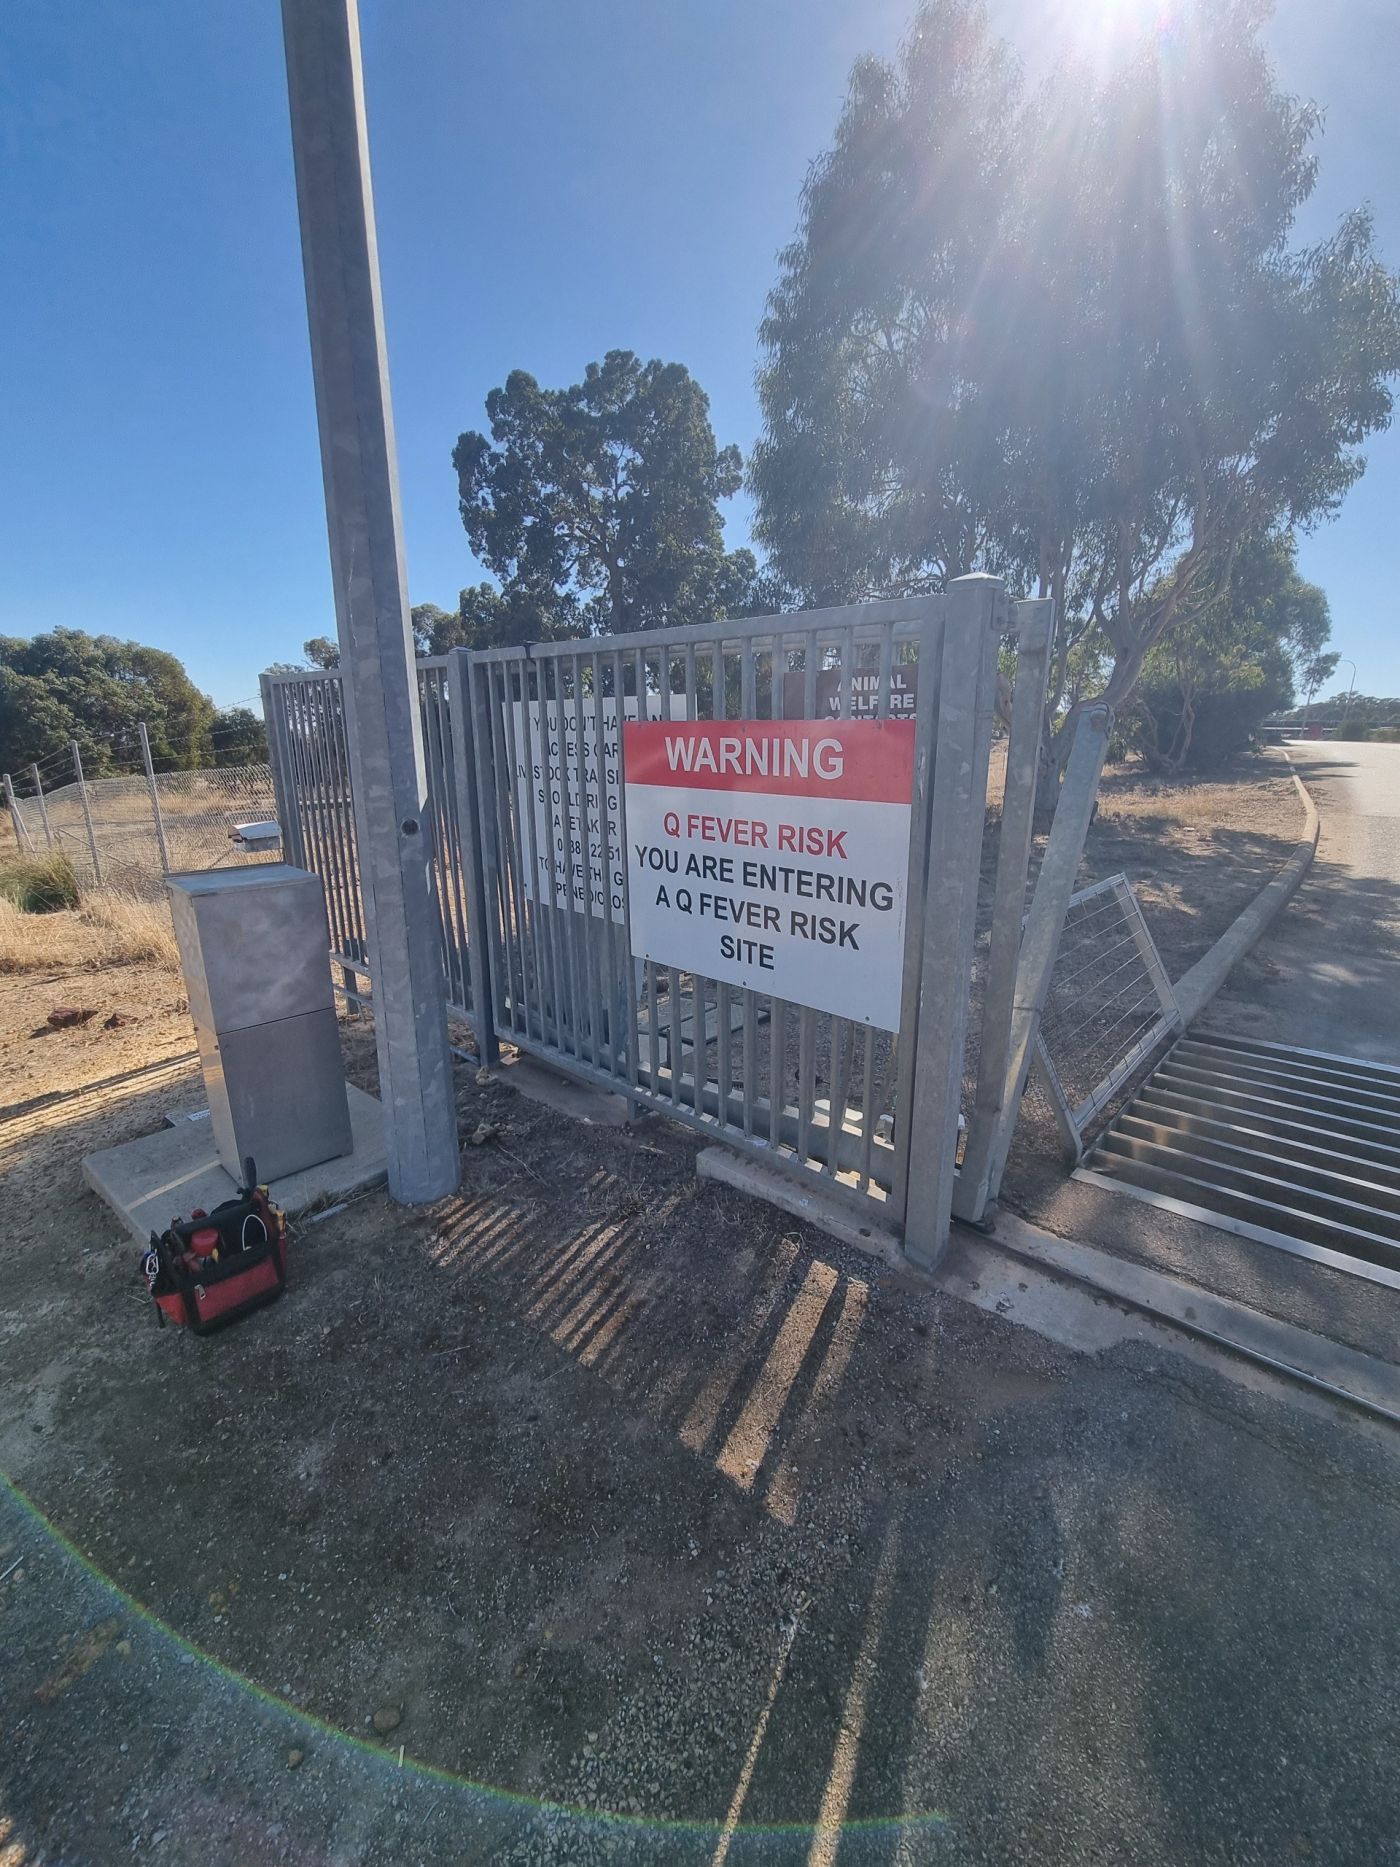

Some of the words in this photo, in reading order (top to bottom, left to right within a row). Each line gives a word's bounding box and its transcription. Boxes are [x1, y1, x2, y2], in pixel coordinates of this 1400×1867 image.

[829, 693, 914, 711] WLFRE
[533, 716, 557, 731] YU
[562, 716, 596, 731] O'T
[547, 742, 590, 757] CES
[593, 742, 619, 758] AR
[664, 736, 844, 780] WARNING
[573, 767, 619, 784] TASI
[538, 789, 581, 806] SOL
[587, 793, 618, 811] RIG
[663, 811, 681, 838] Q
[687, 814, 769, 849] FEVER
[778, 823, 848, 860] RISK
[634, 844, 678, 874] YOU
[685, 853, 734, 884] ARE
[742, 861, 894, 912] ENTERING
[655, 885, 671, 908] A
[676, 888, 693, 915] Q
[700, 892, 781, 933] FEVER
[790, 910, 860, 951] RISK
[720, 935, 775, 971] SITE
